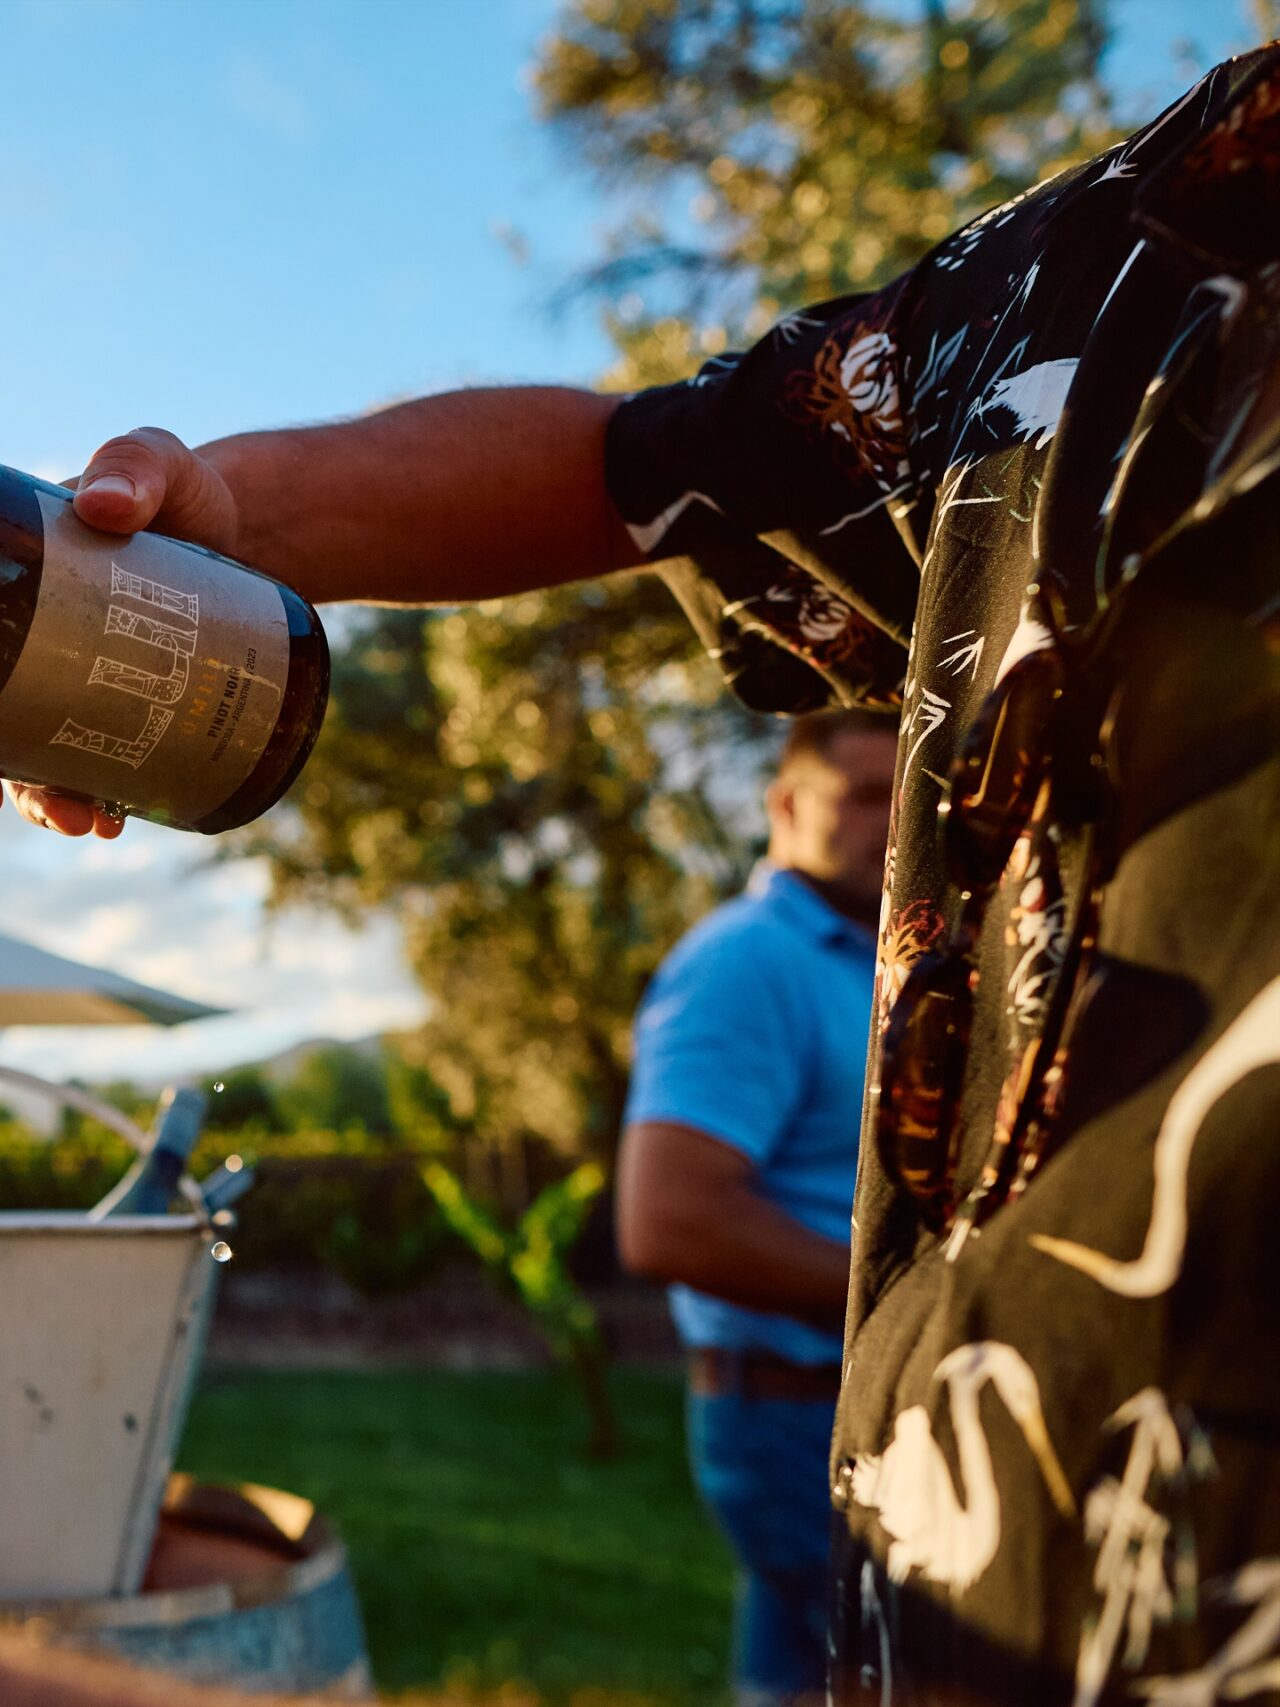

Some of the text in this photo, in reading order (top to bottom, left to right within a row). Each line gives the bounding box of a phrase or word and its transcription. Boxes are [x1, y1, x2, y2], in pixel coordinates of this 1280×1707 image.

[207, 666, 241, 738] PINOT NOIR
[231, 677, 253, 722] ARGENTINA
[246, 647, 257, 670] 2023
